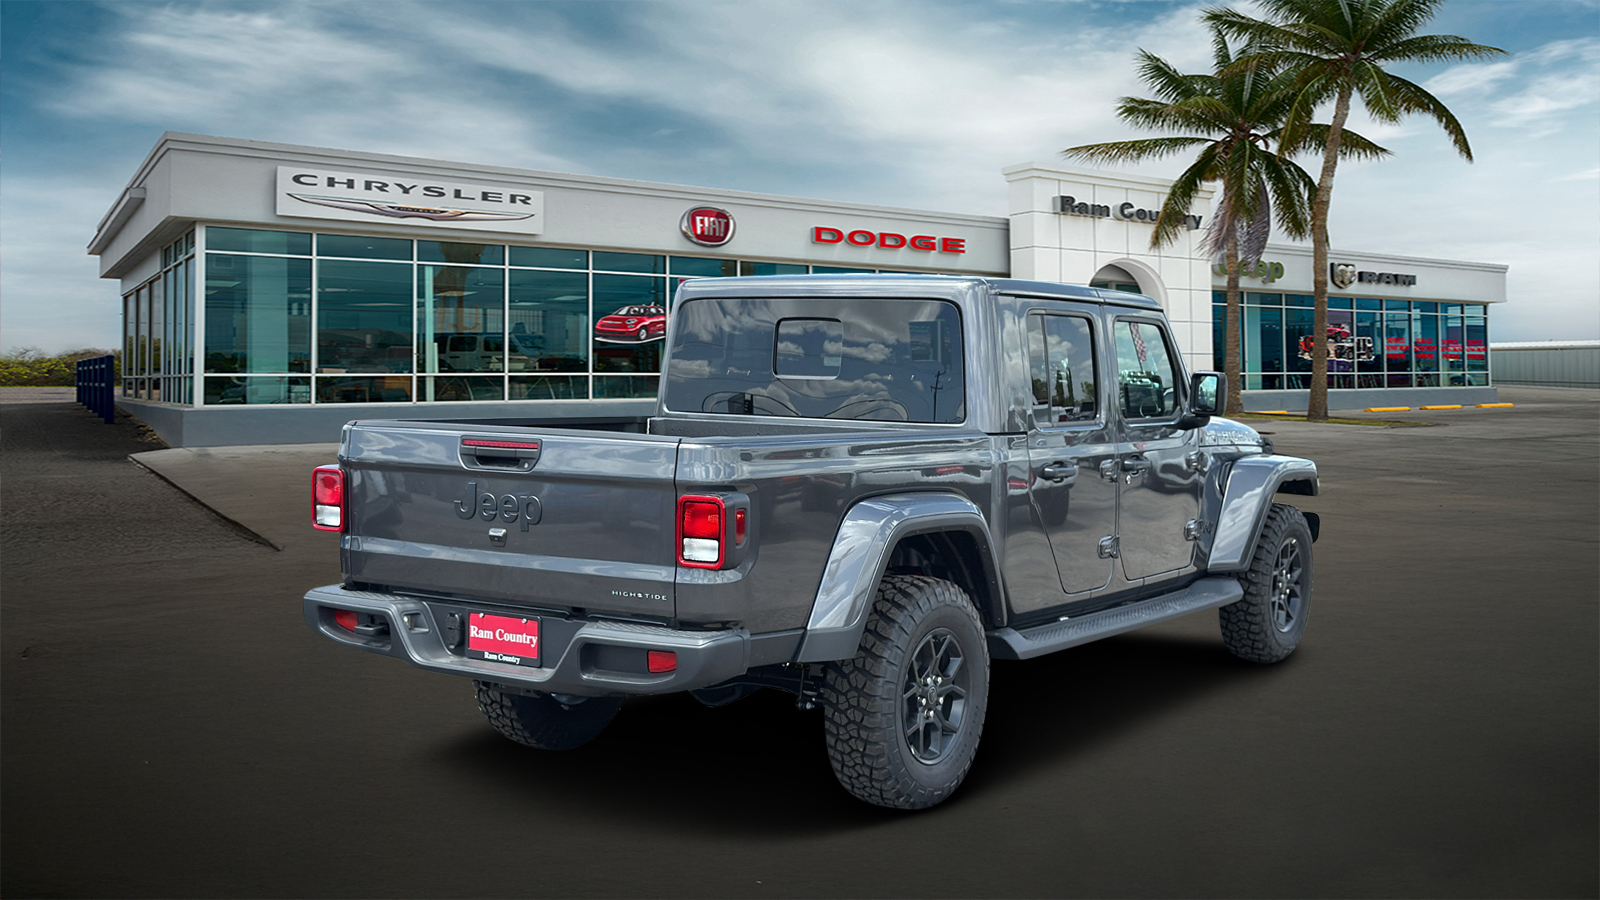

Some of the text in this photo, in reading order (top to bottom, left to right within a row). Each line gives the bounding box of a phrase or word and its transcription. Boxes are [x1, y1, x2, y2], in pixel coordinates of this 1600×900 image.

[292, 174, 532, 205] CHRYSLER
[1058, 195, 1203, 230] Ram Coury
[695, 216, 728, 237] FIAT
[813, 227, 967, 254] DODGE
[1358, 271, 1416, 286] RAM
[454, 482, 542, 532] Jeep
[469, 625, 538, 648] Ram Country
[484, 651, 520, 665] Ram Country
